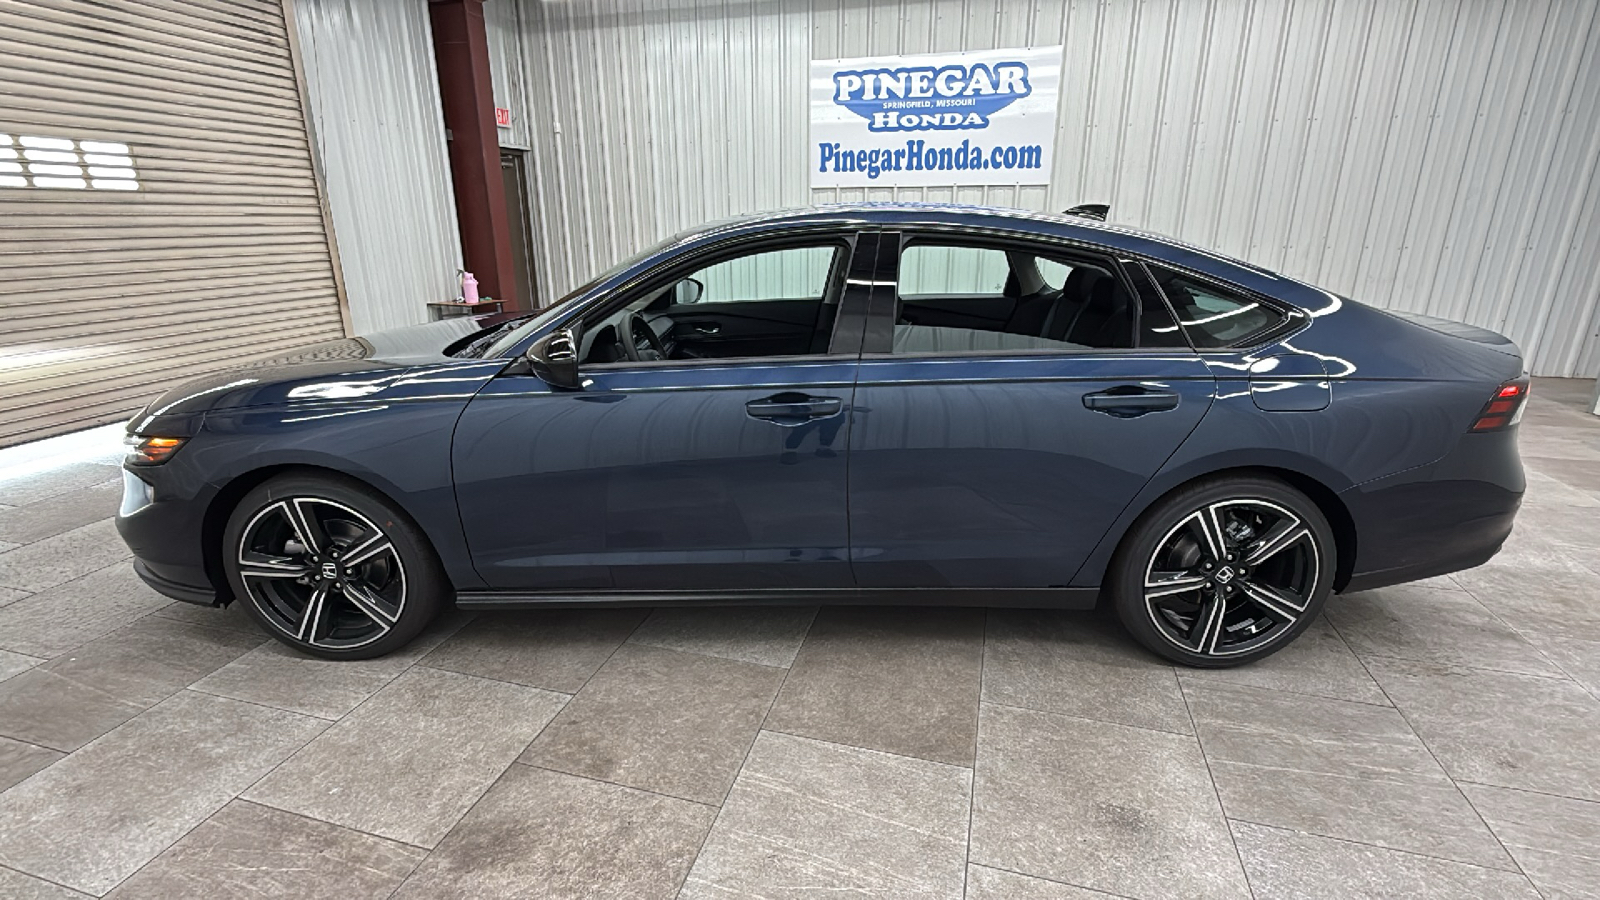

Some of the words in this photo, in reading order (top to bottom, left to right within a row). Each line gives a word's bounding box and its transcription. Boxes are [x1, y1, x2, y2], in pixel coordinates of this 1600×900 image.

[836, 65, 1030, 101] PINEGAR
[883, 101, 933, 109] SPRINGFIELD,
[936, 98, 976, 107] MISSOURI
[496, 107, 509, 125] EXIT
[872, 111, 985, 128] HONDA
[819, 139, 1042, 179] PinegarHonda.com
